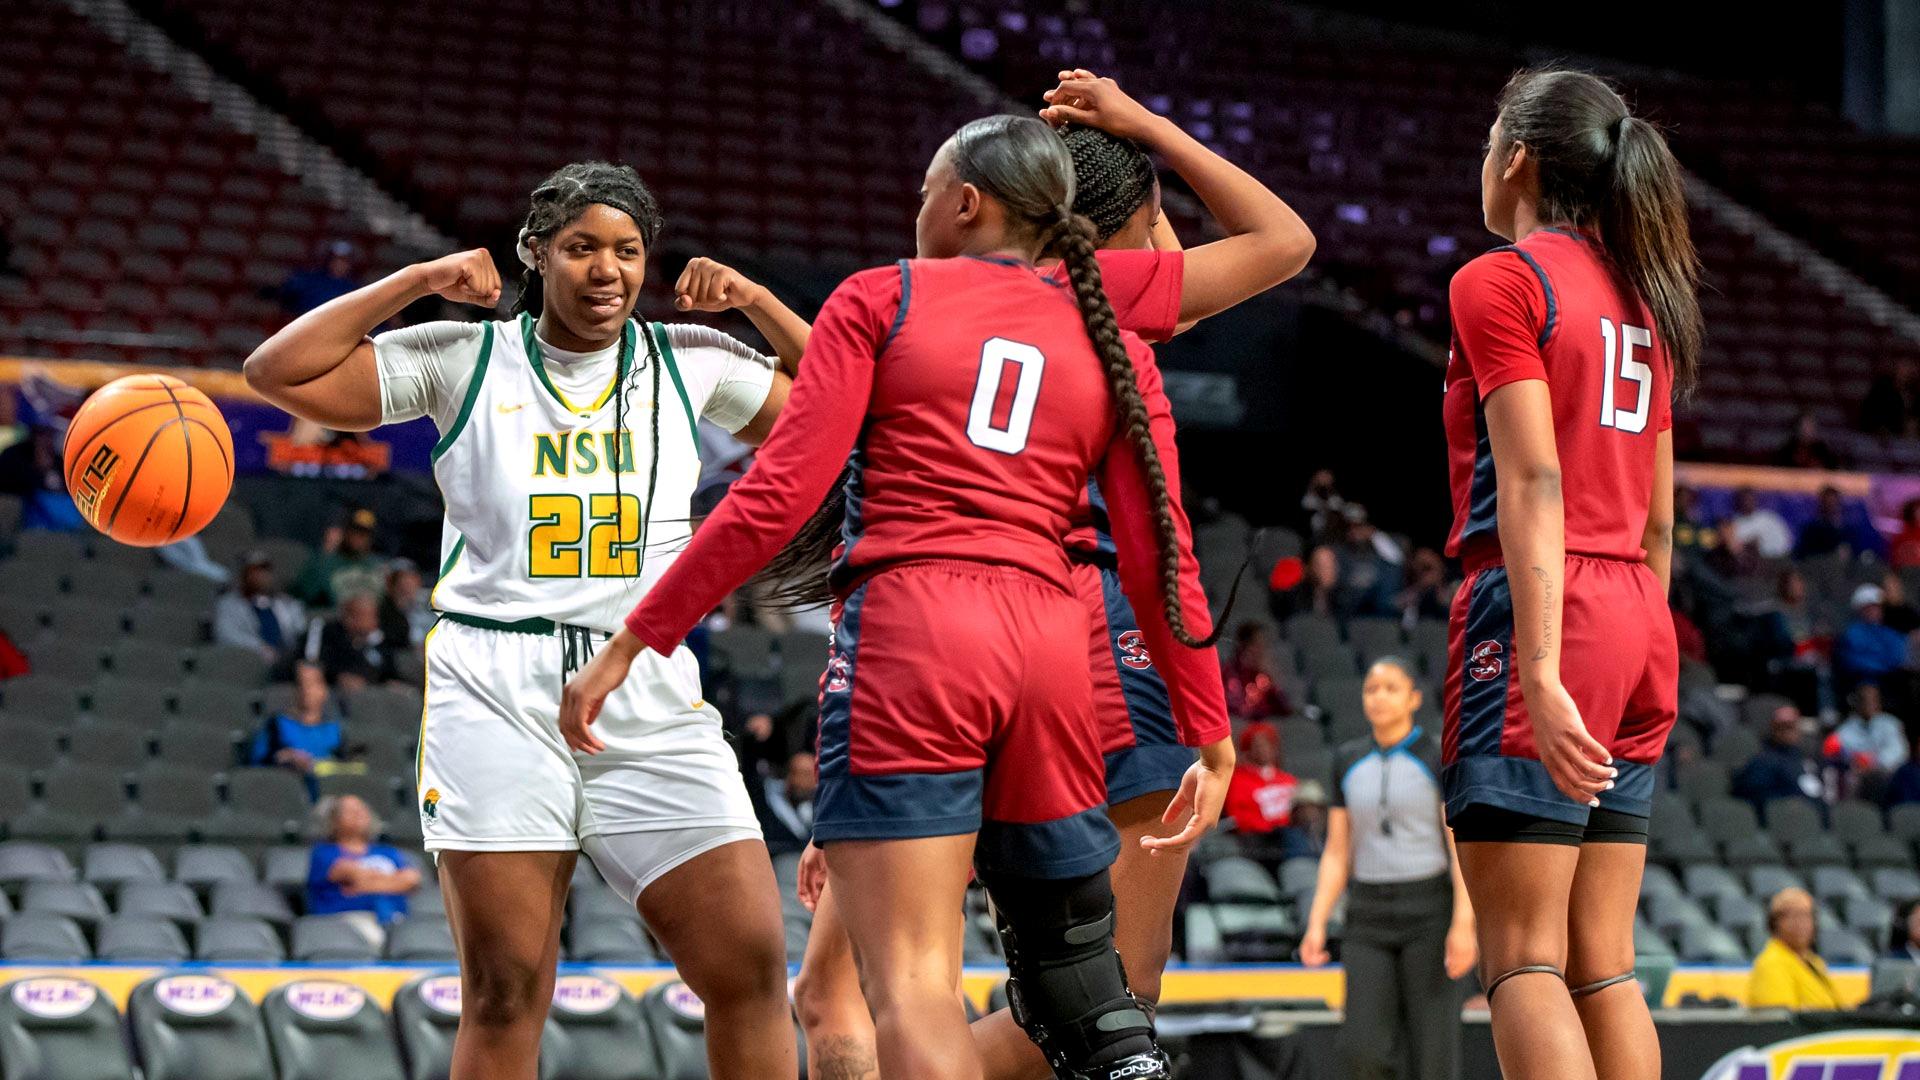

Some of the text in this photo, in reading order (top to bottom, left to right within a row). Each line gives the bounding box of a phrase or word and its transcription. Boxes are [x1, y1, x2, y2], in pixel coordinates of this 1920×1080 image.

[965, 335, 1046, 456] 0
[1599, 316, 1653, 435] 15
[76, 442, 120, 523] ELITE
[531, 429, 639, 478] NSU
[528, 493, 642, 579] 22
[1470, 639, 1503, 682] S
[1109, 1060, 1164, 1080] DONJOY
